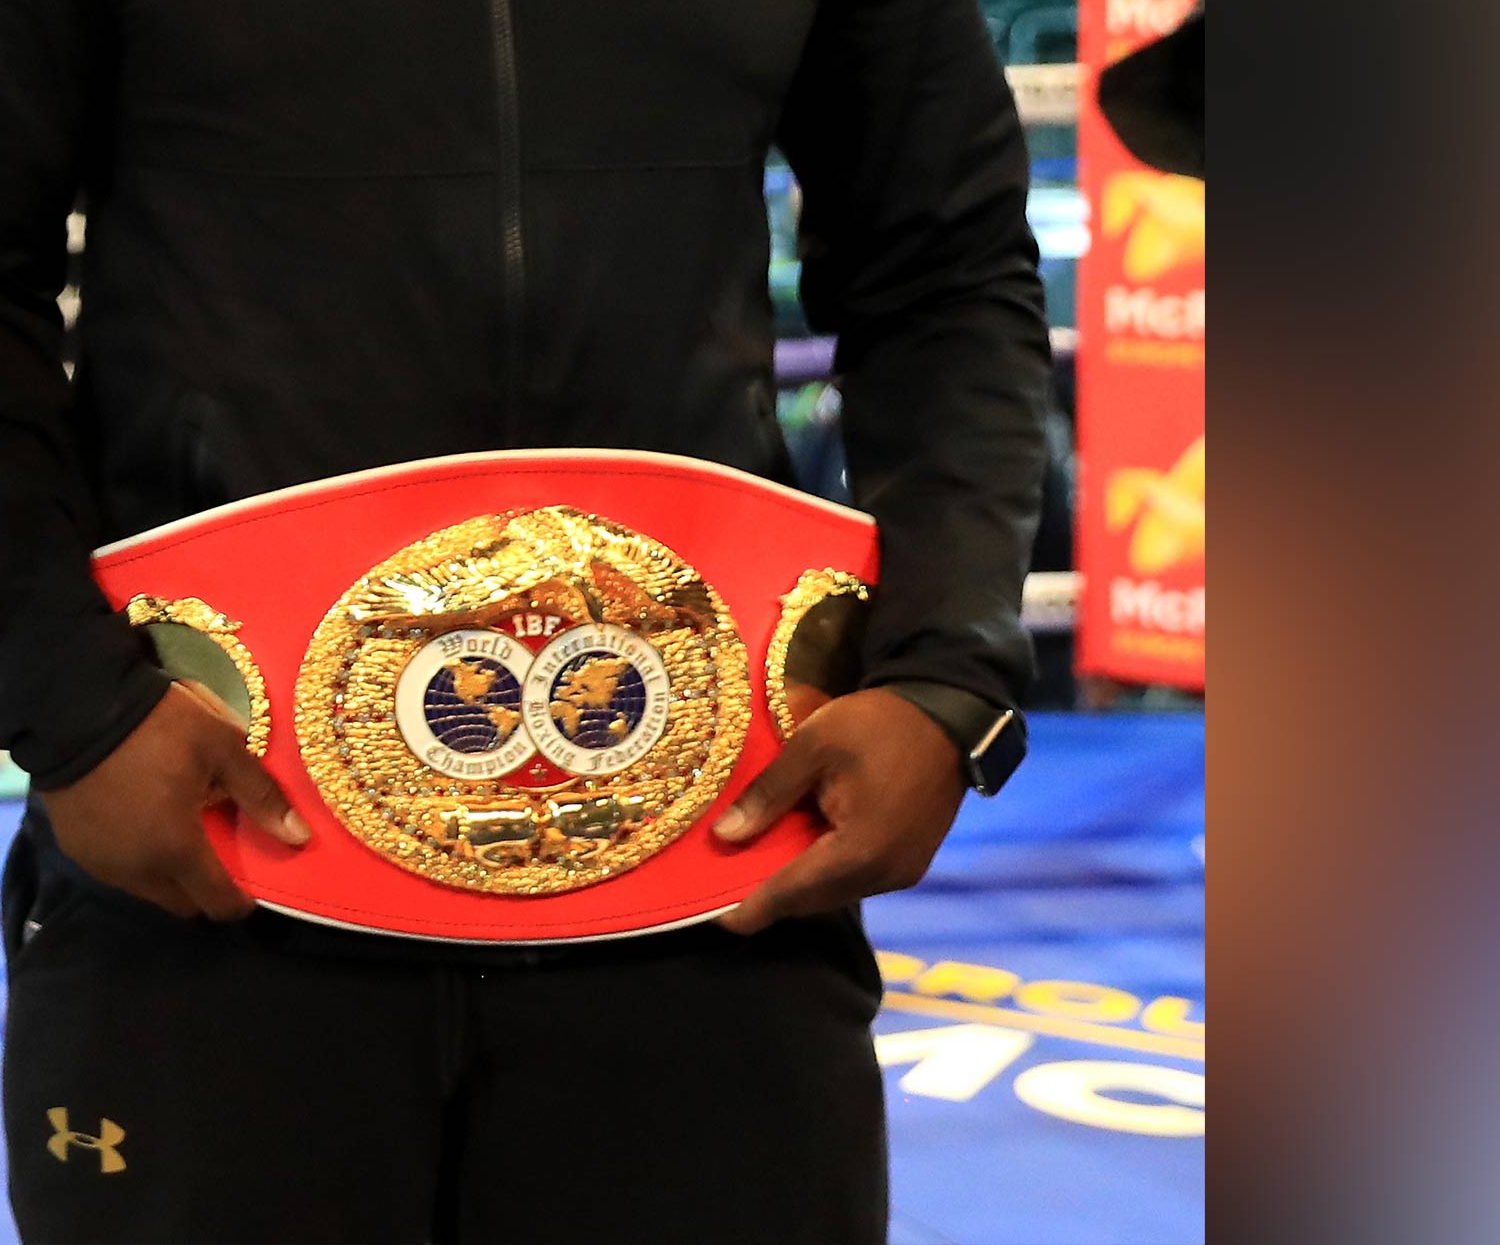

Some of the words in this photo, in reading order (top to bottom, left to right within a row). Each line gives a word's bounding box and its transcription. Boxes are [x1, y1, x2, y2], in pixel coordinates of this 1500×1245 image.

[511, 614, 561, 637] IBF
[435, 632, 514, 660] World
[536, 633, 660, 686] International
[425, 741, 528, 773] Champion
